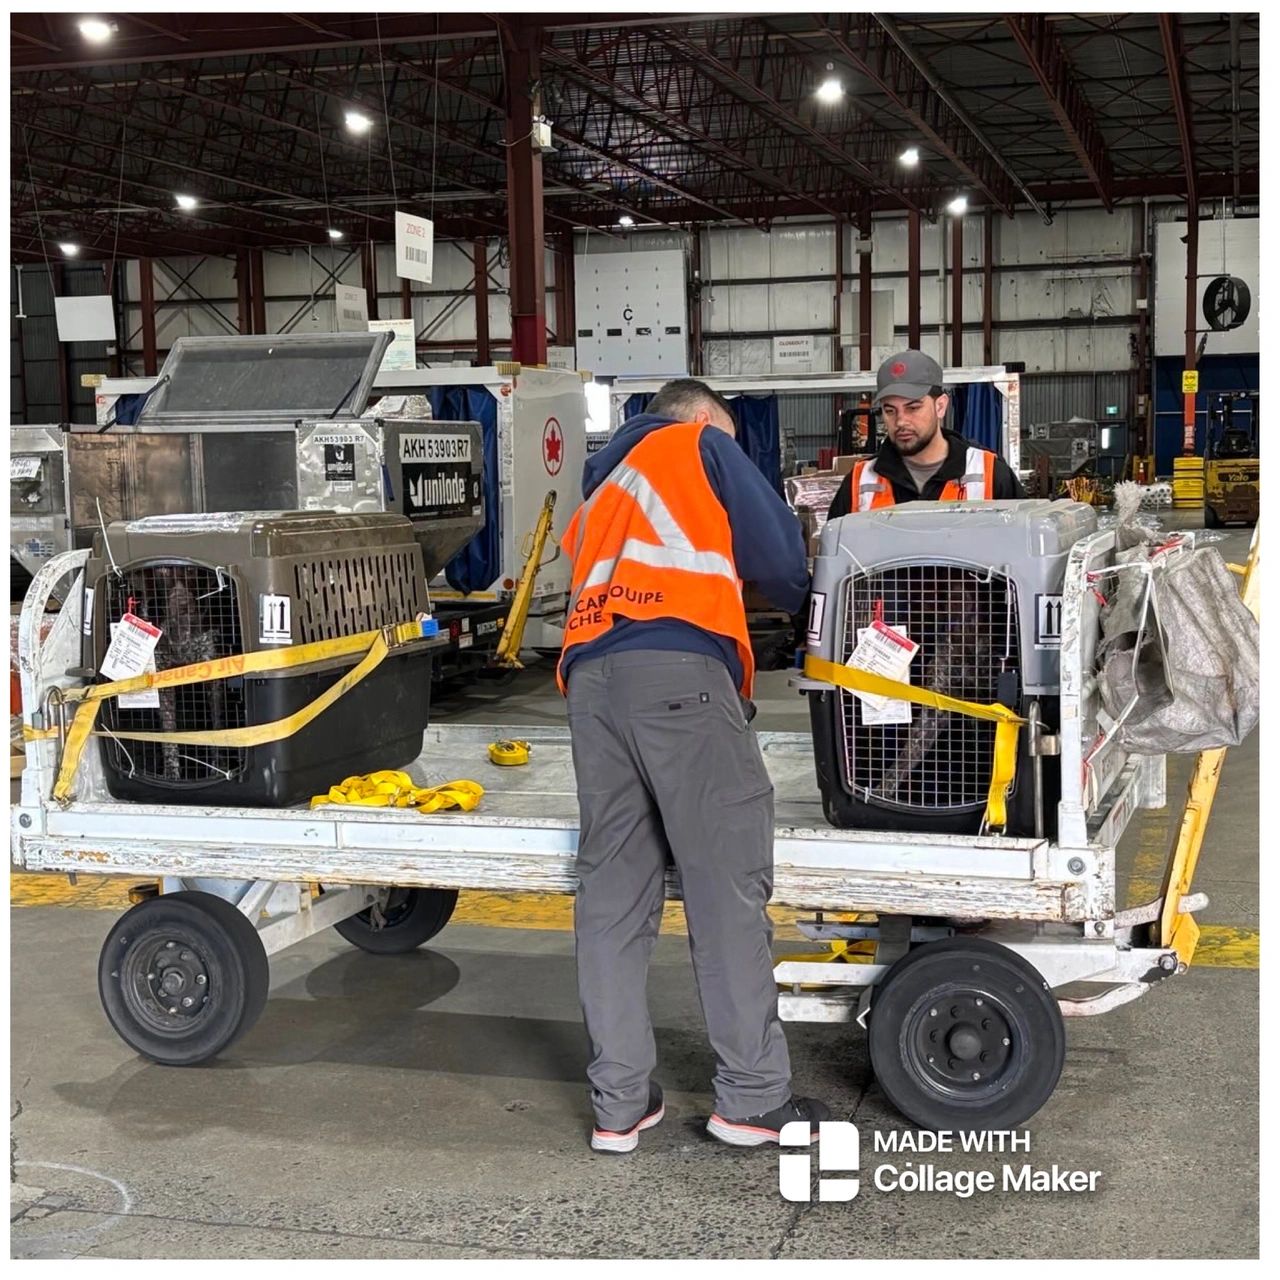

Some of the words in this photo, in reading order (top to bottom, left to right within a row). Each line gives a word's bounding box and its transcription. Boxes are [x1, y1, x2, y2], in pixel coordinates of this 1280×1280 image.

[406, 223, 421, 237] ZONE
[421, 227, 426, 239] 2
[623, 309, 633, 321] C
[327, 462, 353, 472] unilode
[1228, 472, 1249, 482] Yale
[424, 472, 466, 505] unilode
